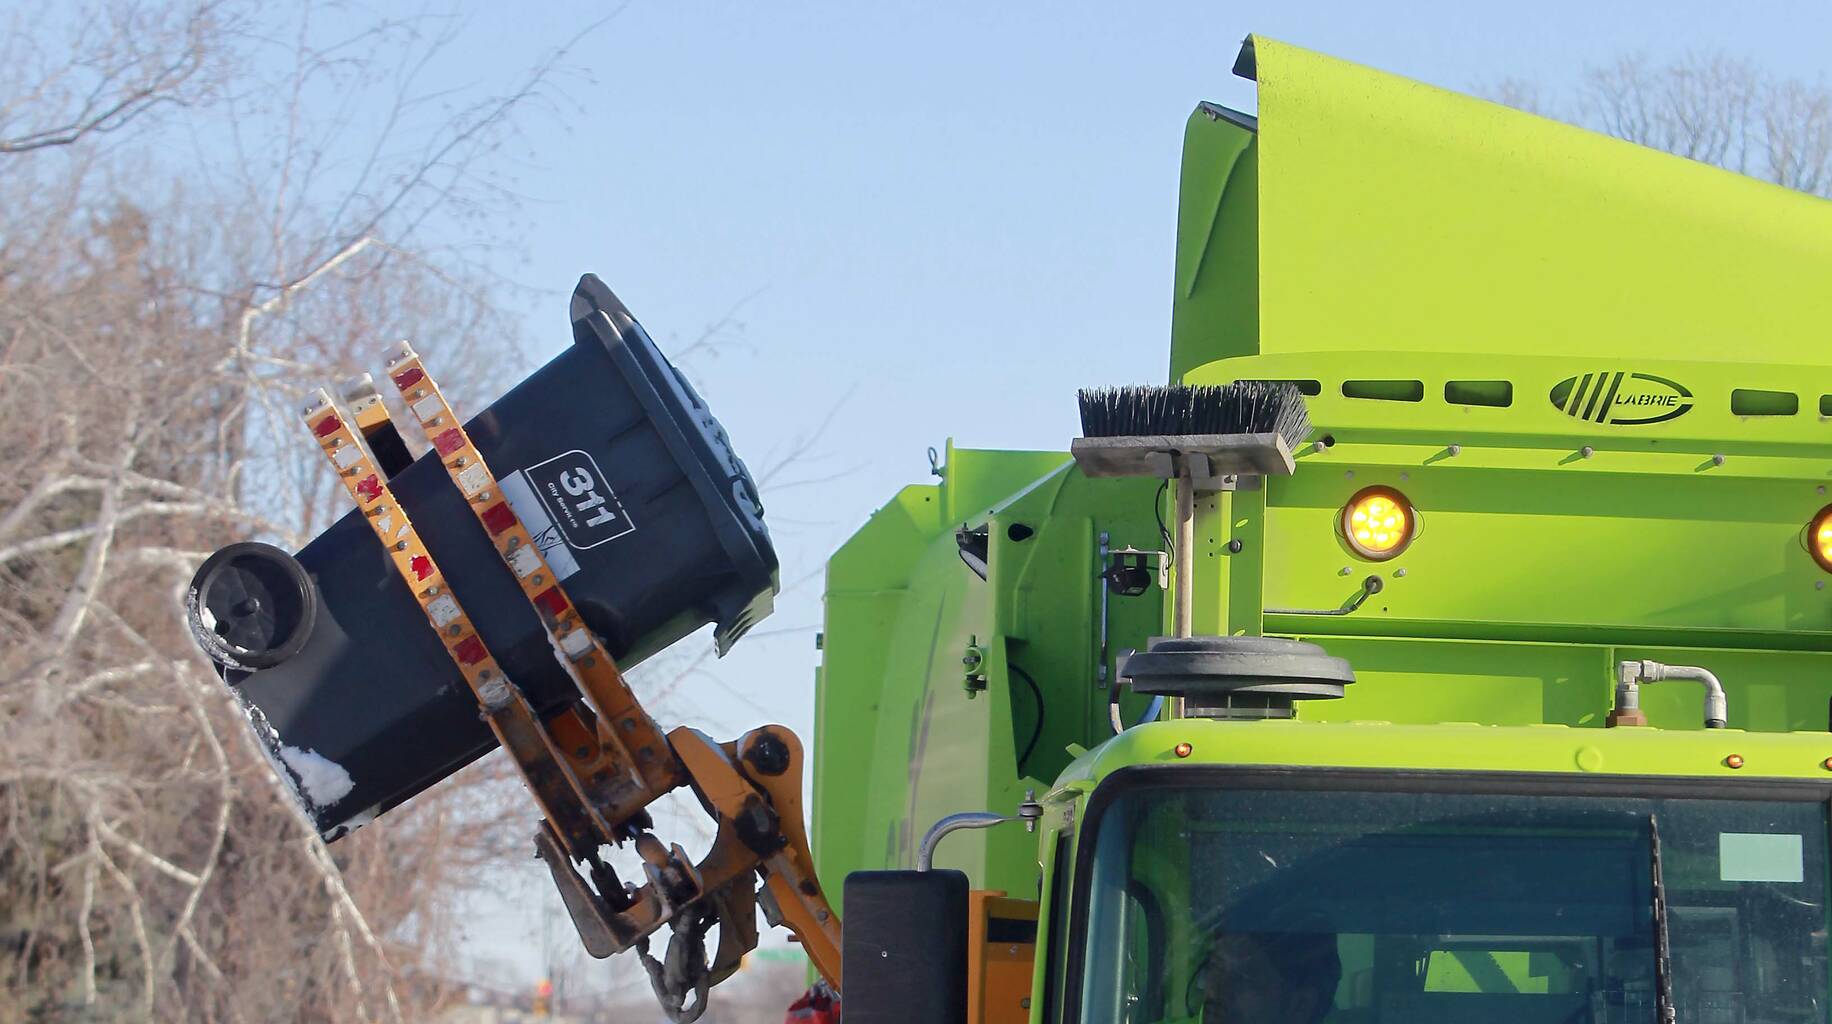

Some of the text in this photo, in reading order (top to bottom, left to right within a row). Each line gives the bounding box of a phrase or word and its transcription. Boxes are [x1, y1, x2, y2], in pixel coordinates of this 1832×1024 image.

[1615, 394, 1678, 407] LABRIE
[547, 482, 560, 498] City
[560, 467, 616, 527] 311
